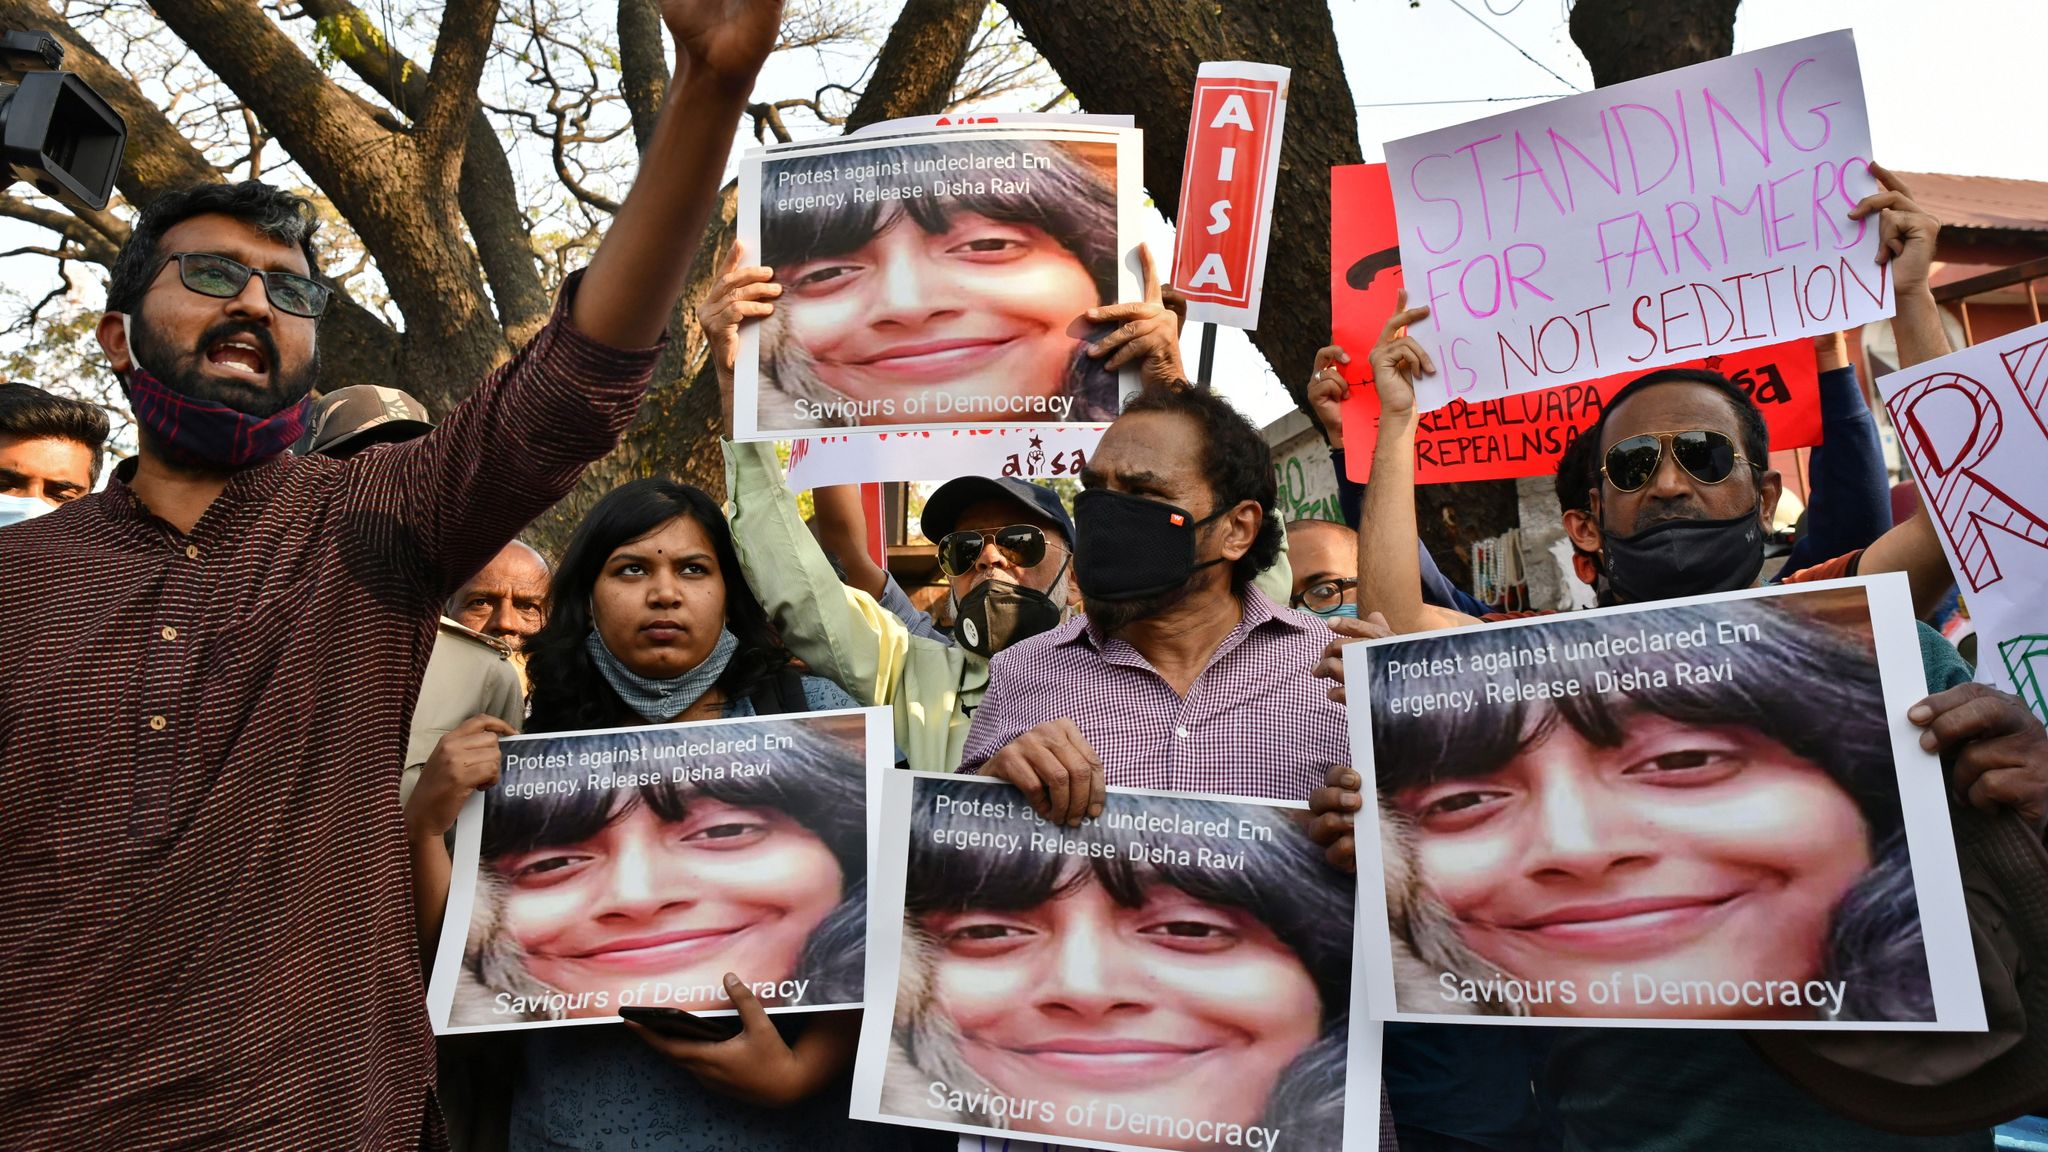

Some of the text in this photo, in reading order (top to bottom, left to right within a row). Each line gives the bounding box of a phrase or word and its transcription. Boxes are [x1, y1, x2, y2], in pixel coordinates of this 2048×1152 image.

[778, 152, 1051, 188] Protest against undeclared Em
[1411, 58, 1841, 255] STANDING
[778, 178, 1031, 213] ergency. Release Disha Ravi
[1188, 94, 1254, 292] AISA
[1426, 155, 1870, 332] FOR FARMERS
[1438, 256, 1888, 398] IS NOT SEDITION
[793, 391, 1074, 420] Saviours of Democracy
[1387, 620, 1761, 682] Protest against undeclared Em
[1389, 658, 1734, 717] ergency. Release Disha Ravi
[506, 734, 793, 771] Protest against undeclared Em
[504, 760, 771, 799] ergency. Release Disha Ravi
[935, 794, 1014, 818] Protest
[1107, 811, 1229, 840] undeclared
[1237, 821, 1272, 842] Em
[933, 826, 1245, 871] ergency. Release Disha Ravi
[492, 977, 809, 1016] Saviours of Demoracy
[1439, 971, 1847, 1015] Saviours of Democracy
[926, 1081, 1055, 1123] Saviours
[1066, 1100, 1100, 1128] of
[1106, 1103, 1280, 1152] Democracy
